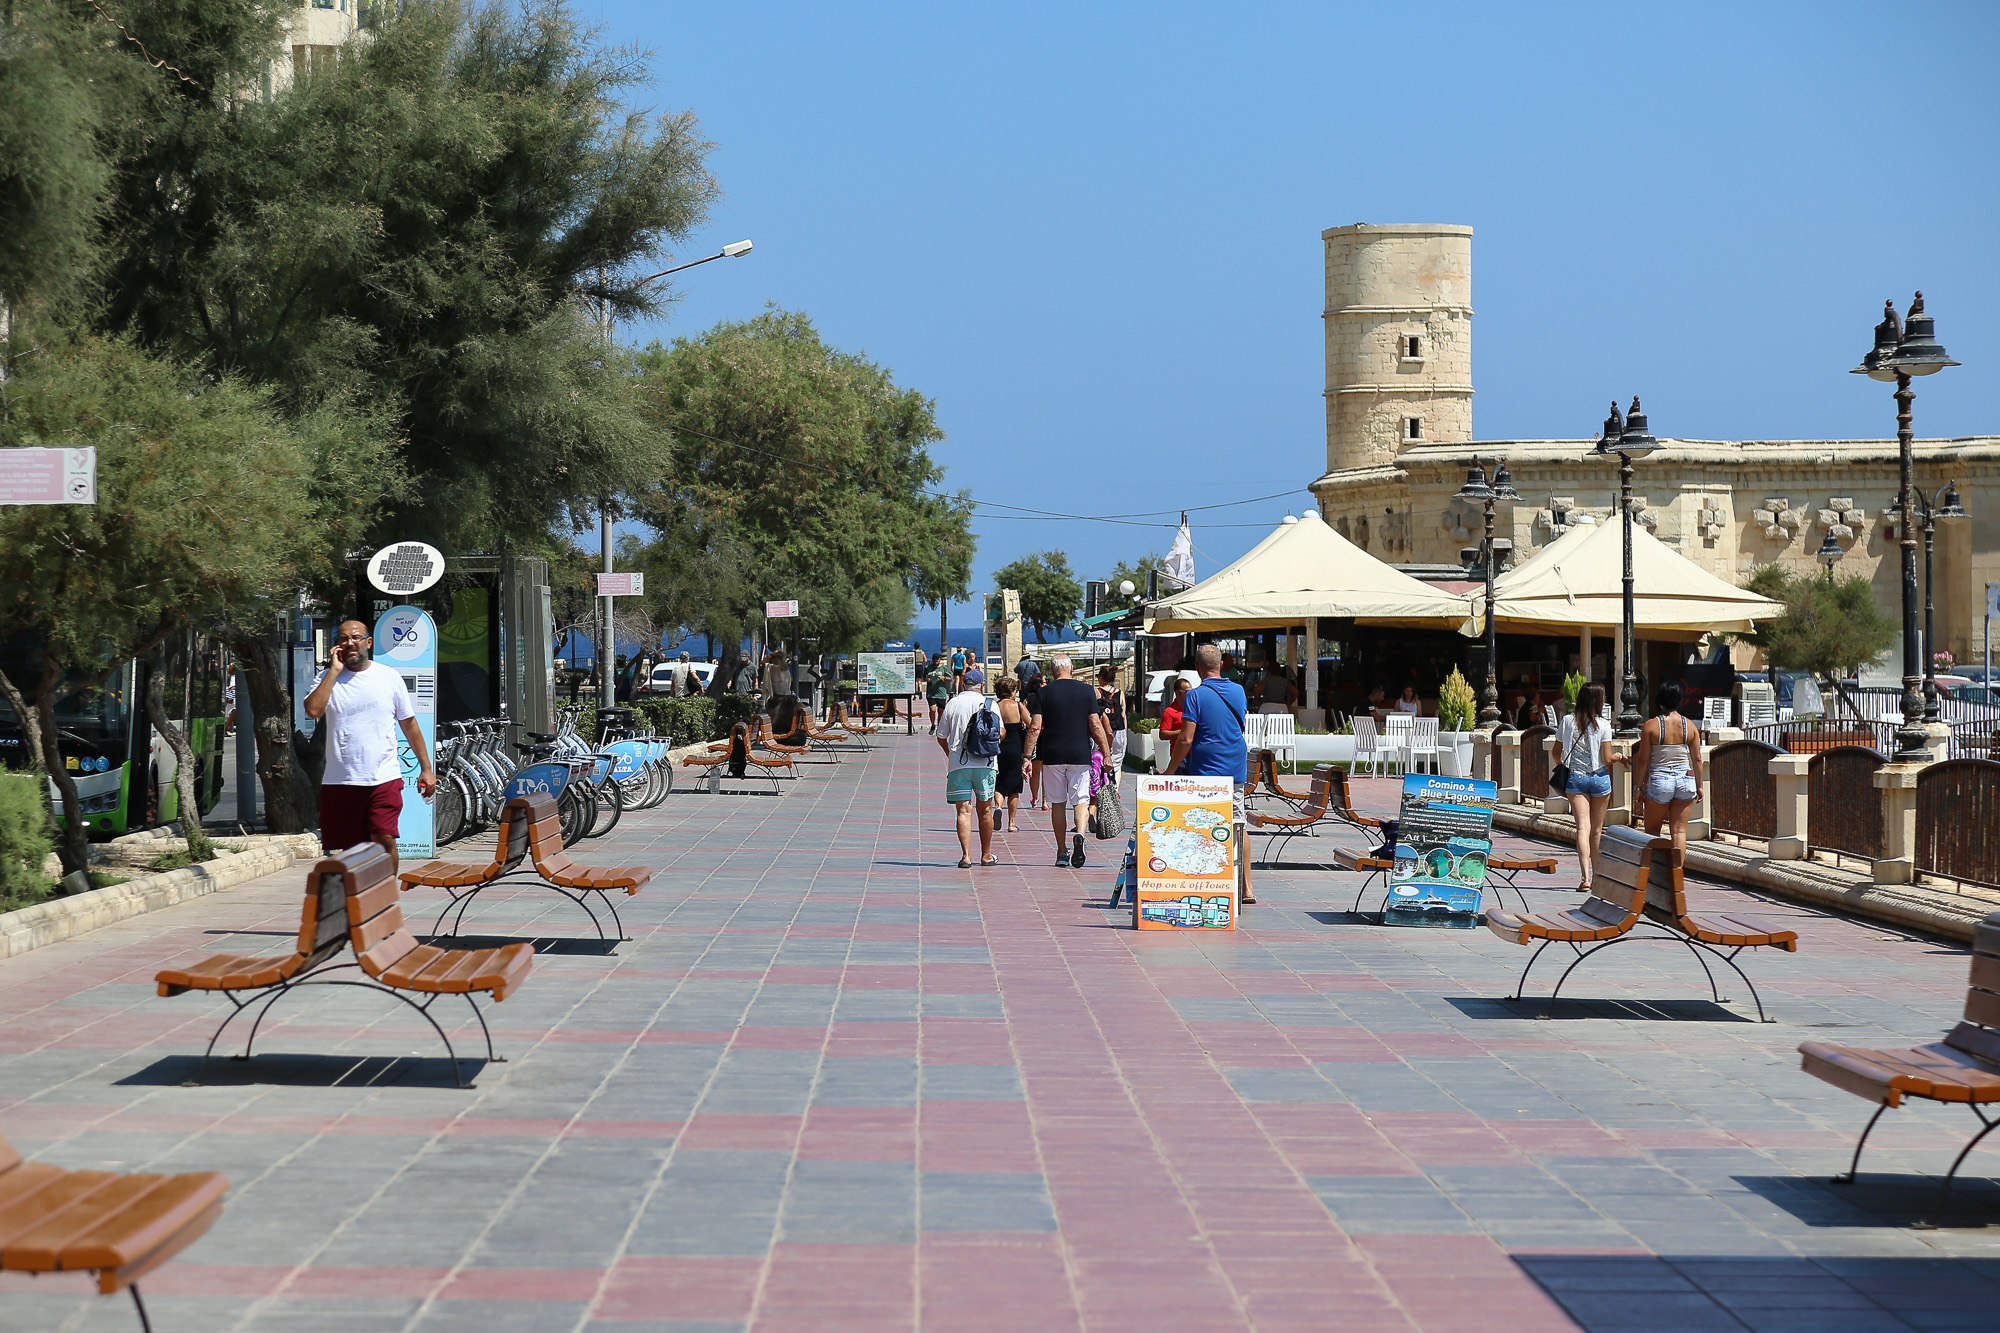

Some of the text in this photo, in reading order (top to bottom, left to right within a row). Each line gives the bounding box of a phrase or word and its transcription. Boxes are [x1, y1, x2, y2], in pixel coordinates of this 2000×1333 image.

[1428, 779, 1475, 792] Comino &
[1420, 788, 1480, 802] Blue Lagoon
[1142, 880, 1162, 889] Hop
[1189, 881, 1204, 890] off
